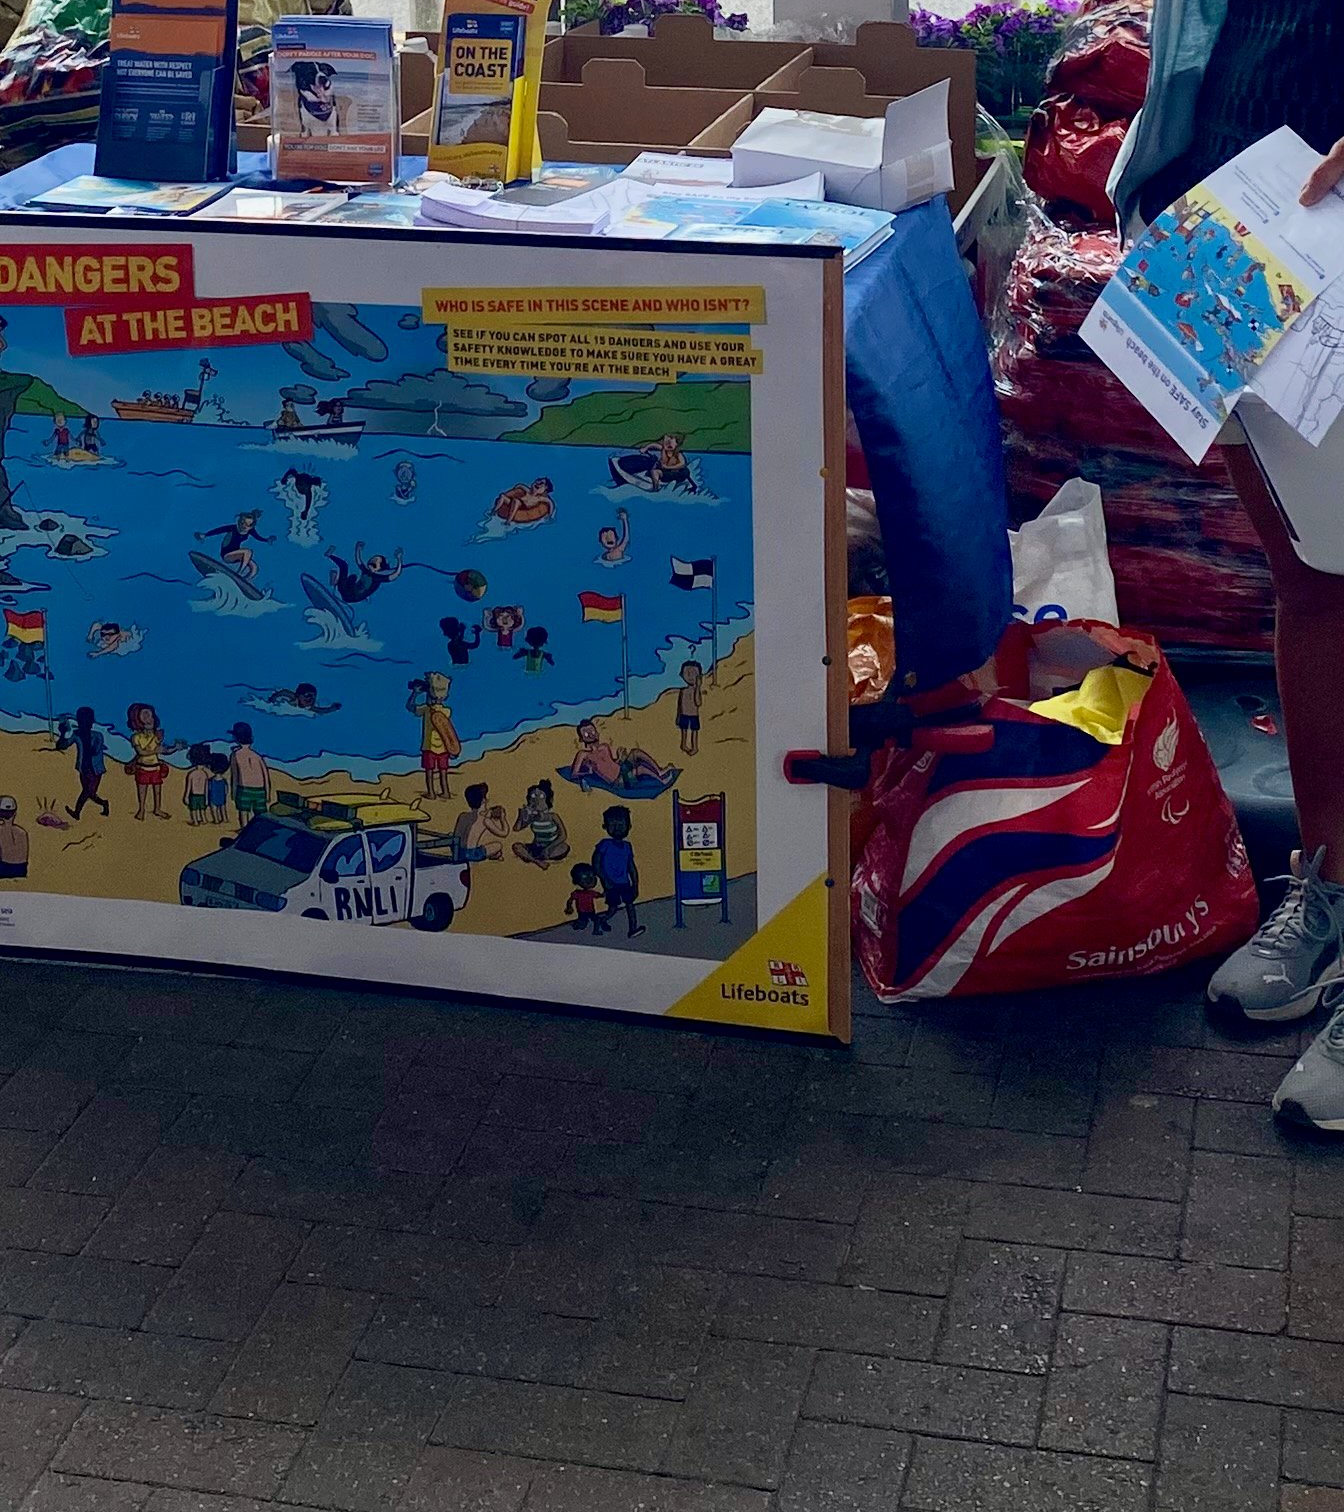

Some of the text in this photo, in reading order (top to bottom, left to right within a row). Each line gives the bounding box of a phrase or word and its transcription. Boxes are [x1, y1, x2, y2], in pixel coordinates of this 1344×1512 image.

[455, 45, 508, 61] ON THE
[454, 62, 508, 78] COAST
[435, 298, 750, 313] WHO IS SAFE IN THIS SCENE AND WHO ISN'T?
[79, 302, 299, 346] AT THE BEACH
[453, 329, 745, 353] SEE IF YOU CAN SPOT ALL 15 DANGERS AND USE YOUR
[453, 342, 757, 368] SAFETY KNOWLEDGE TO MAKE SURE YOU HAVE A GREAT
[453, 356, 670, 377] TIME EVERY TIME YOU'RE AT THE BEACH
[1126, 337, 1209, 429] Stay SAFE on the beach
[335, 885, 399, 921] RNLI
[721, 983, 809, 1007] Lifeboats
